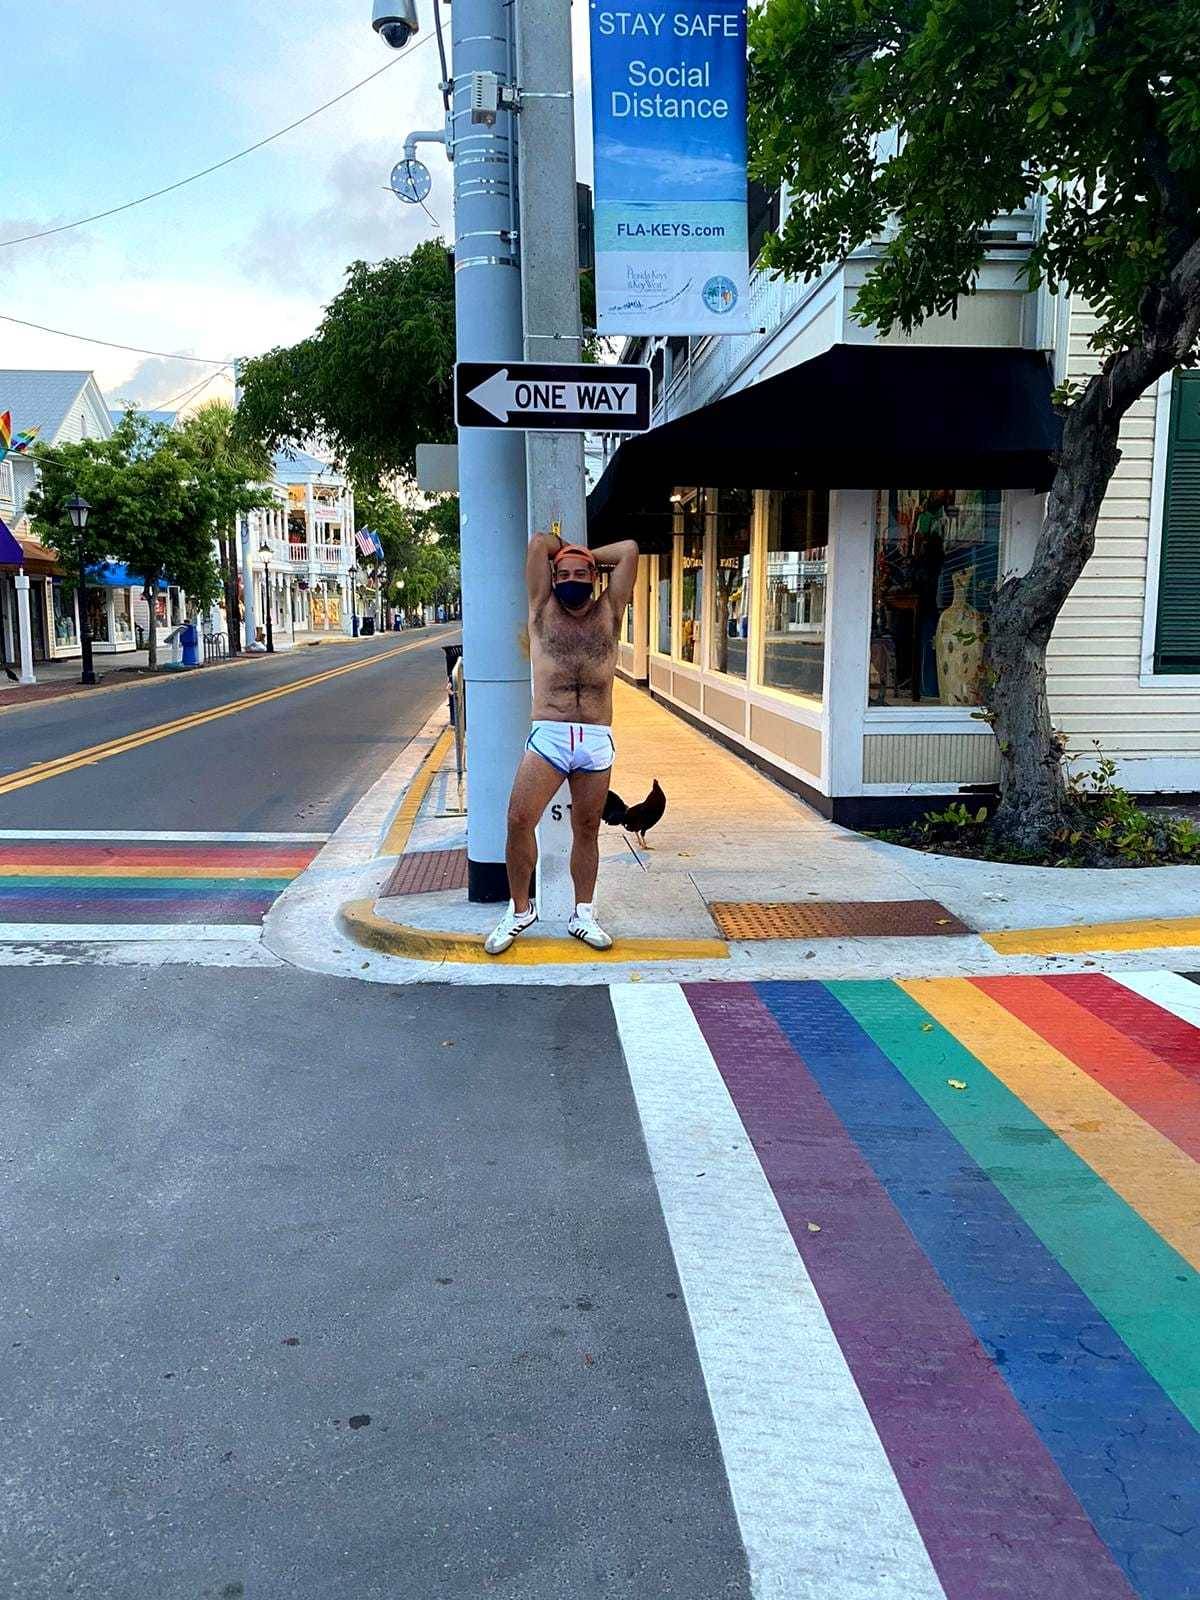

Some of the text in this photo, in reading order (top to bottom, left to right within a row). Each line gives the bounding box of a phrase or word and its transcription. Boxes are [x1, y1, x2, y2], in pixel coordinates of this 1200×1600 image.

[599, 12, 739, 37] STAY SAFE
[628, 60, 710, 87] Social
[611, 91, 729, 119] Distance
[617, 223, 725, 237] FLA-KEYS.com
[515, 384, 629, 411] ONE WAY
